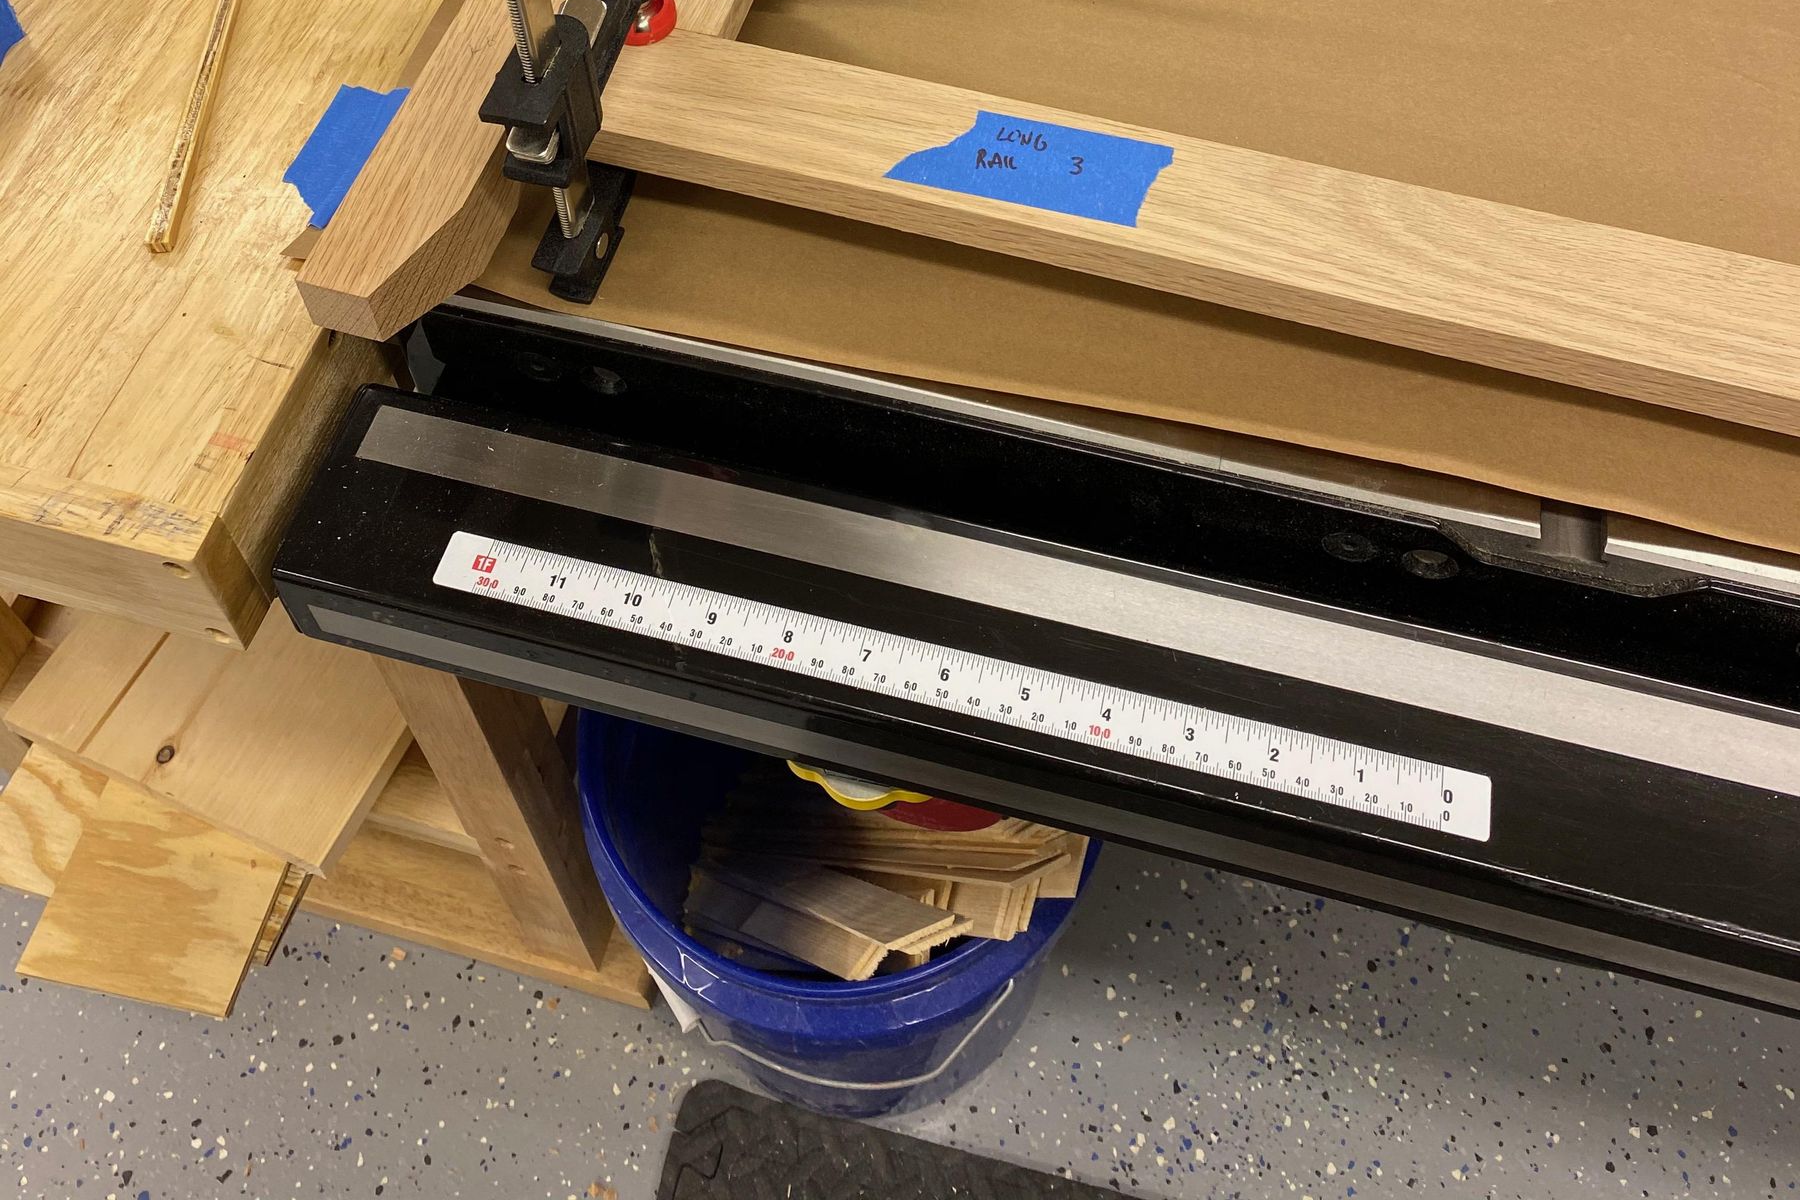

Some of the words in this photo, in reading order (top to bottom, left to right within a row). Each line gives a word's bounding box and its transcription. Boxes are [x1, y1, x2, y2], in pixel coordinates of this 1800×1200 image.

[996, 127, 1048, 152] LONG
[975, 148, 1018, 170] RAIL
[1069, 156, 1085, 176] 3
[475, 556, 495, 572] 1F
[550, 575, 567, 589] 11
[624, 592, 643, 607] 10
[707, 612, 718, 625] 9
[783, 630, 794, 644] 8
[862, 649, 872, 663] 7
[940, 668, 950, 682] 6
[1020, 687, 1031, 701] 5
[1101, 708, 1112, 722] 4
[1185, 728, 1195, 742] 3
[1269, 748, 1280, 763] 2
[1356, 769, 1365, 783] 1
[1443, 789, 1454, 804] 0
